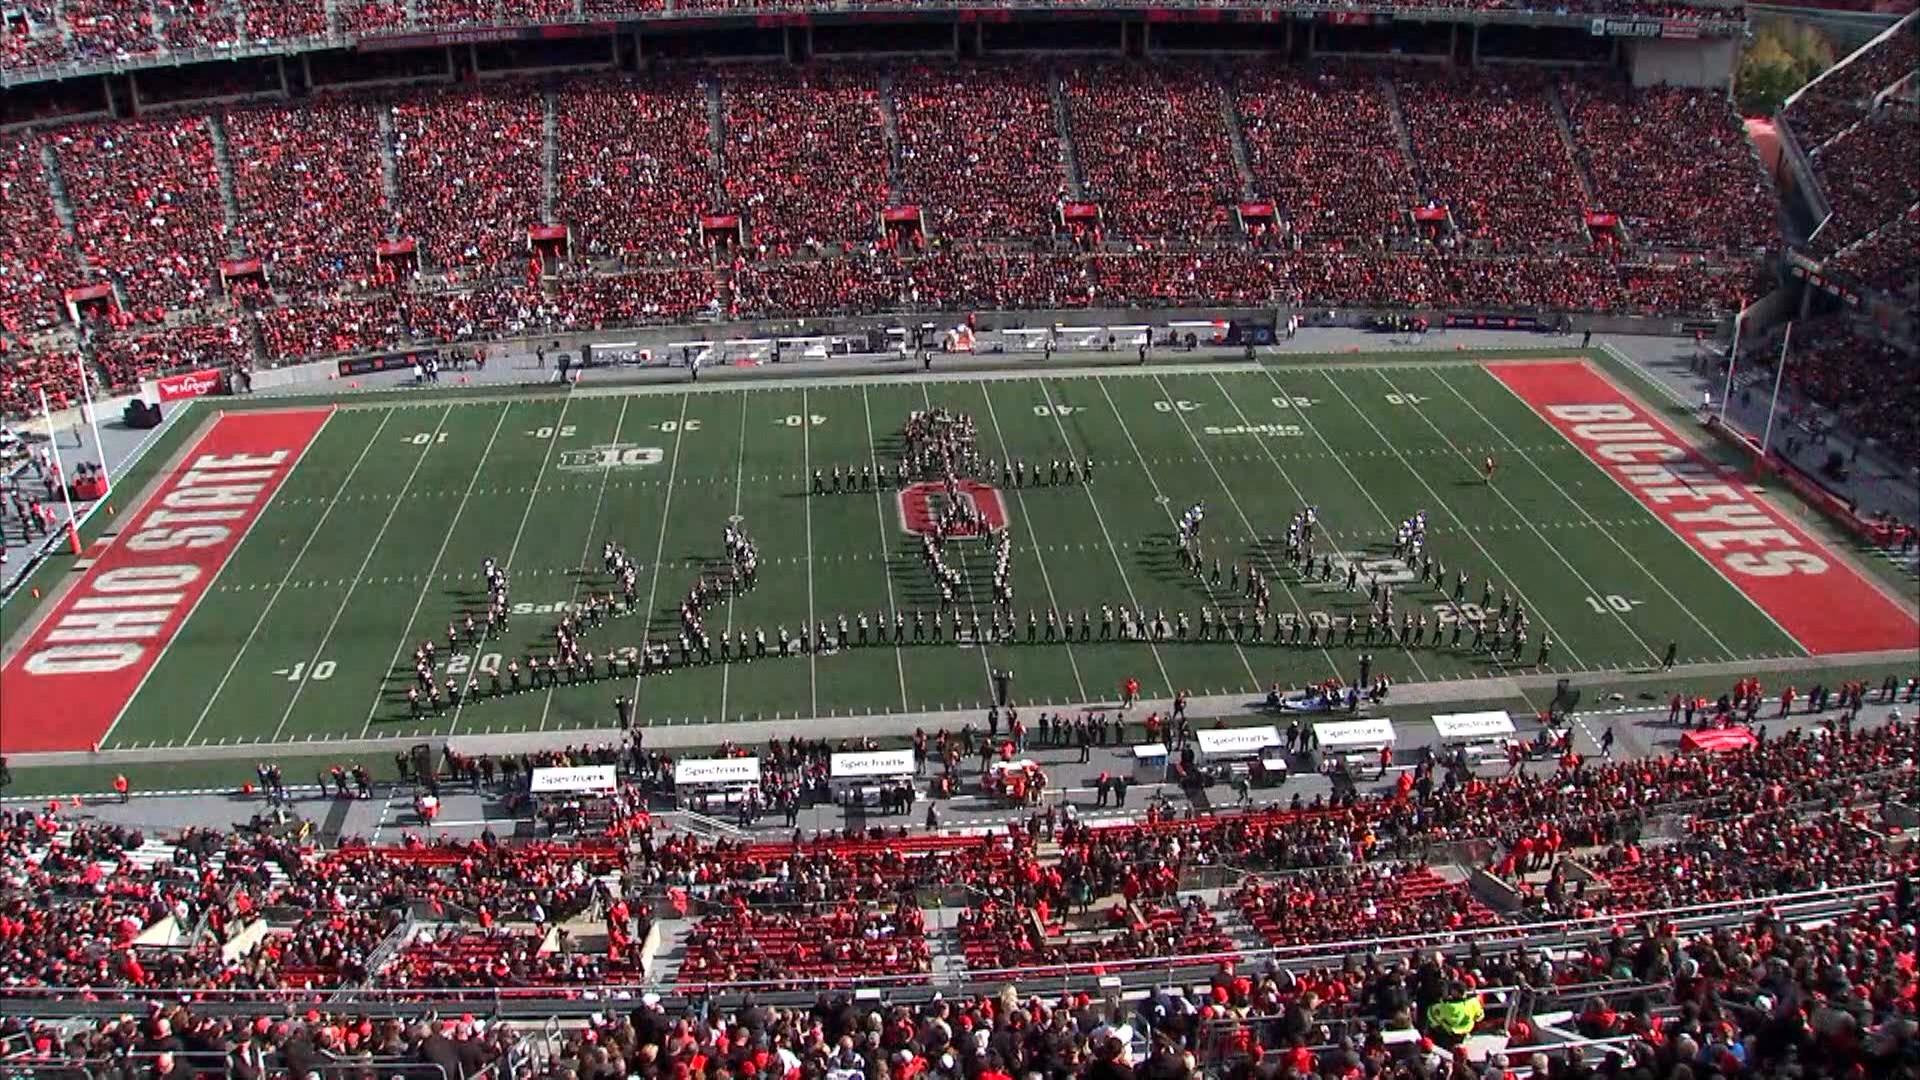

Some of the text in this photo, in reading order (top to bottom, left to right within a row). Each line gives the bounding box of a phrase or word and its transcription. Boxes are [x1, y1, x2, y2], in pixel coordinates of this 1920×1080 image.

[1546, 405, 1830, 576] BUCKEYES
[23, 449, 292, 675] OHIO STATE
[1586, 594, 1633, 613] 10
[288, 660, 337, 681] 10
[446, 652, 503, 674] 20
